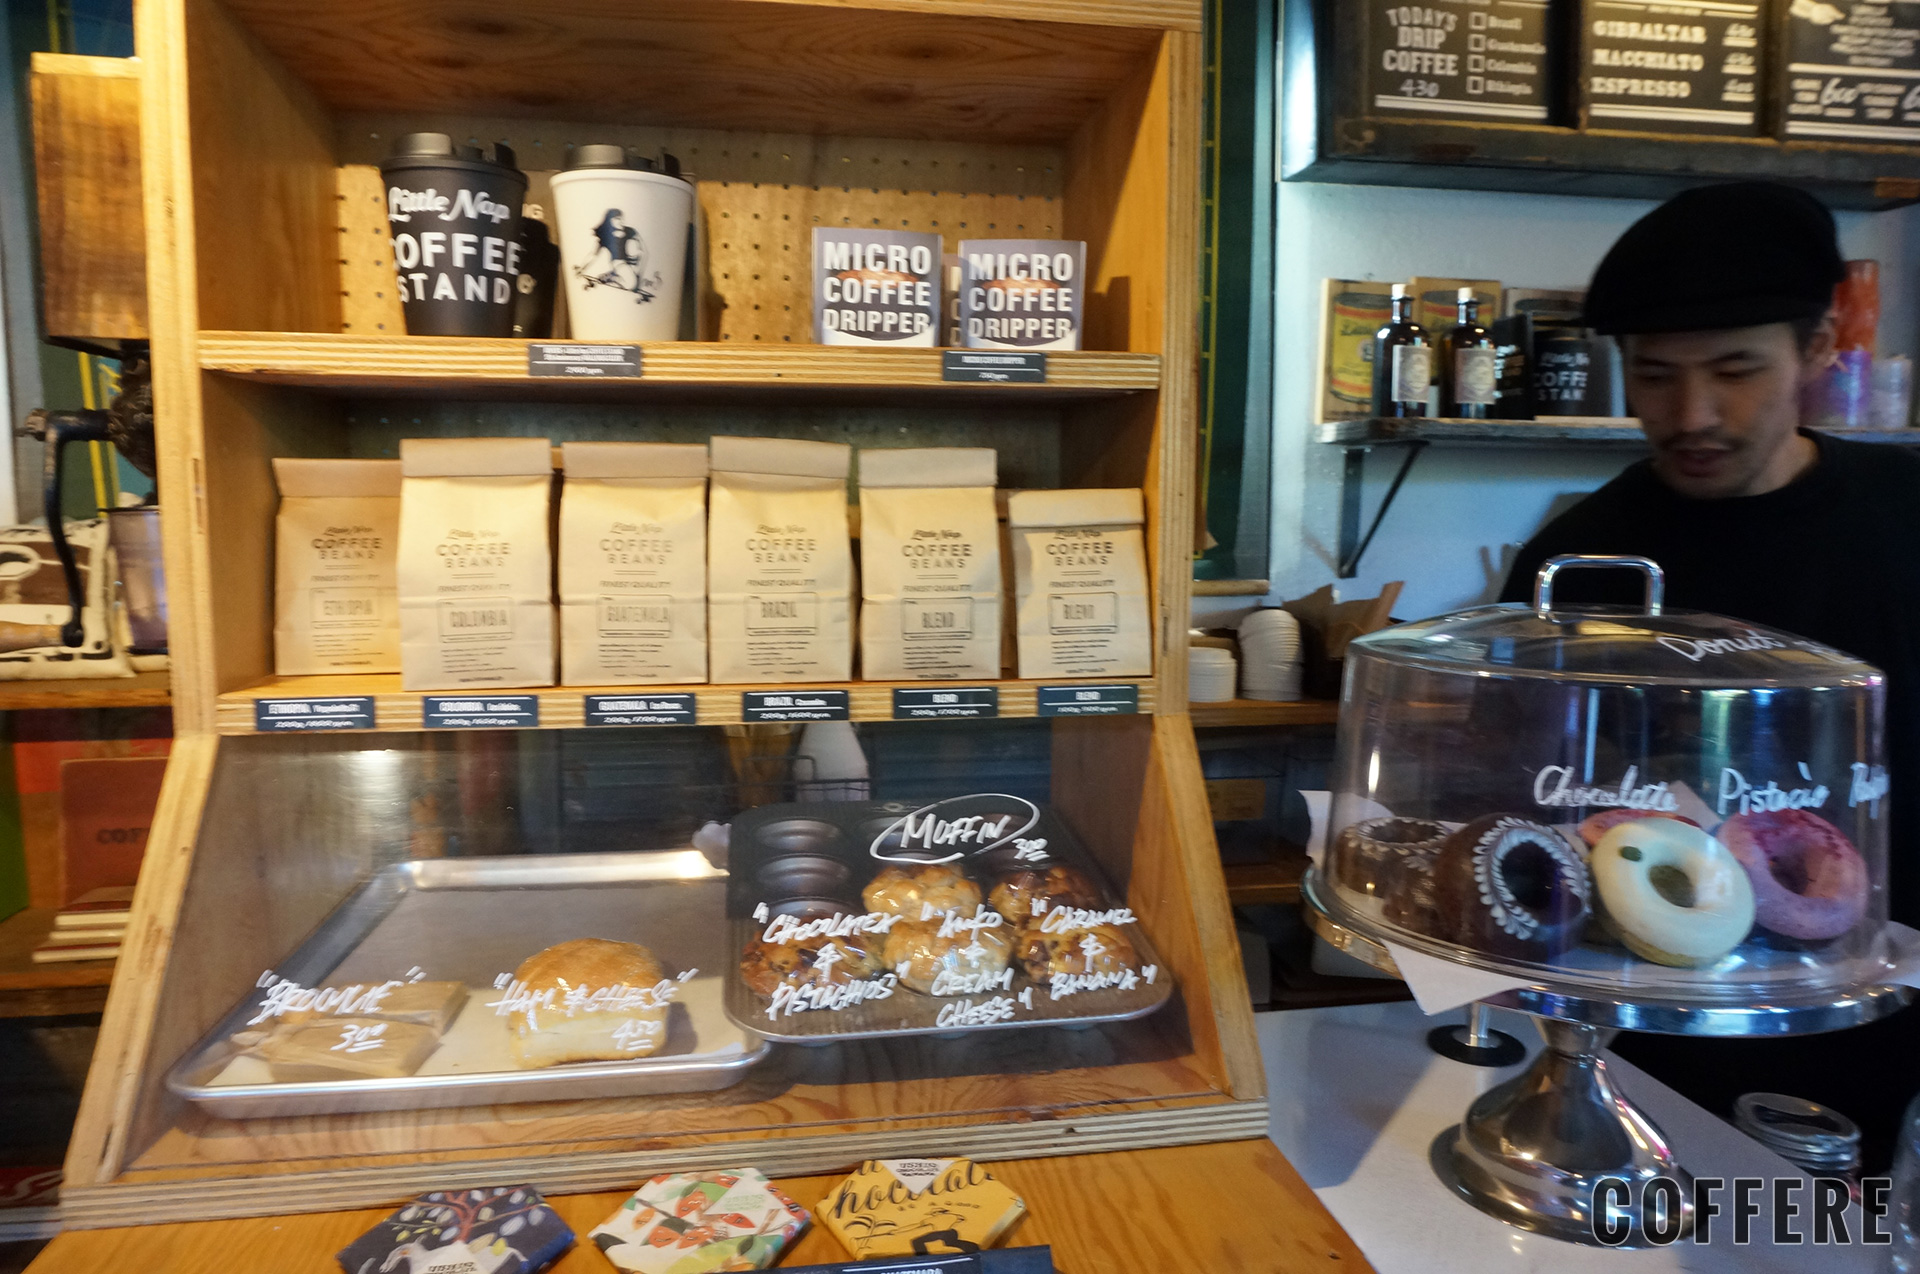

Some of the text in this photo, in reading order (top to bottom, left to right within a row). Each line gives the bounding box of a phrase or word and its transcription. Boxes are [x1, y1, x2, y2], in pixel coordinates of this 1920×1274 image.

[1386, 6, 1458, 32] TODAY'S
[1397, 26, 1446, 49] DRIP
[1593, 20, 1707, 44] GIBRALTAR
[1382, 50, 1459, 76] COFFEE
[1592, 48, 1704, 72] MACCHIATO
[1590, 76, 1691, 98] ESPRESSO
[388, 187, 449, 222] Little
[438, 189, 510, 224] Nap
[389, 232, 521, 276] OFFEE
[823, 241, 931, 275] MICRO
[968, 253, 1074, 281] MICRO
[397, 273, 511, 304] STAND
[823, 277, 931, 307] COFFEE
[968, 287, 1073, 312] COFFEE
[823, 308, 930, 333] DRIPPER
[968, 317, 1072, 339] DRIPPER
[312, 538, 382, 549] COFFEE
[319, 550, 375, 559] BEANS
[436, 543, 511, 556] COFFEE
[600, 539, 673, 552] COFFEE
[745, 538, 817, 551] COFFEE
[902, 544, 972, 557] COFFEE
[1046, 542, 1114, 555] COFFEE
[445, 557, 504, 568] BEANS
[607, 554, 665, 564] BEANS
[754, 553, 810, 563] BEANS
[910, 558, 966, 569] BEANS
[1055, 556, 1108, 566] BEANS
[1533, 765, 1679, 812] Chocolate
[900, 813, 1012, 849] MUFFIN
[931, 967, 1015, 996] CREAM
